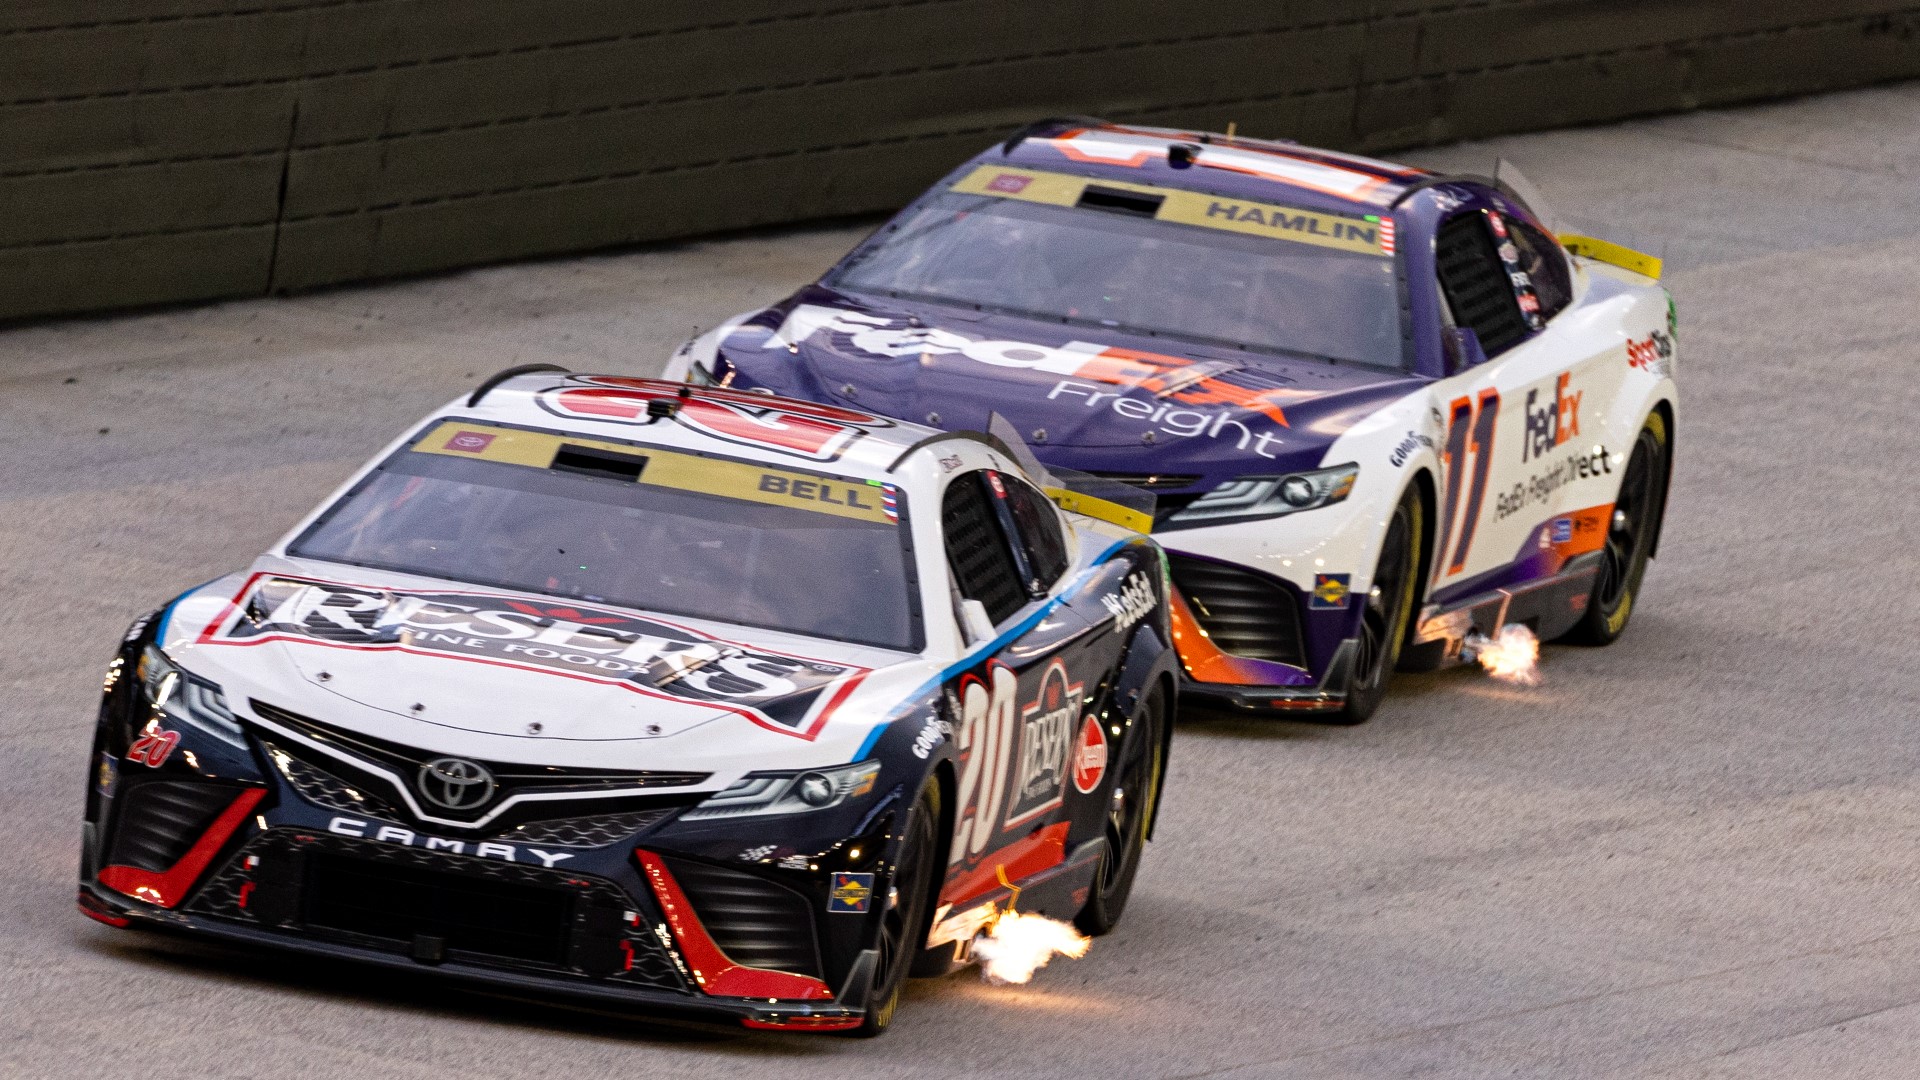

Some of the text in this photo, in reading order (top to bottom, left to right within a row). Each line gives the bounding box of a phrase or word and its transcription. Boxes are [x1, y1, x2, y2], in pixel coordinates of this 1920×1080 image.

[1205, 201, 1376, 245] HAMLIN
[1046, 380, 1284, 459] Freight
[1522, 371, 1583, 464] FedEx
[758, 474, 873, 510] BELL
[1431, 386, 1501, 588] 11
[394, 626, 650, 675] FINE FOODS
[125, 724, 181, 769] 20
[947, 657, 1018, 866] 20
[328, 817, 575, 868] CAMRY
